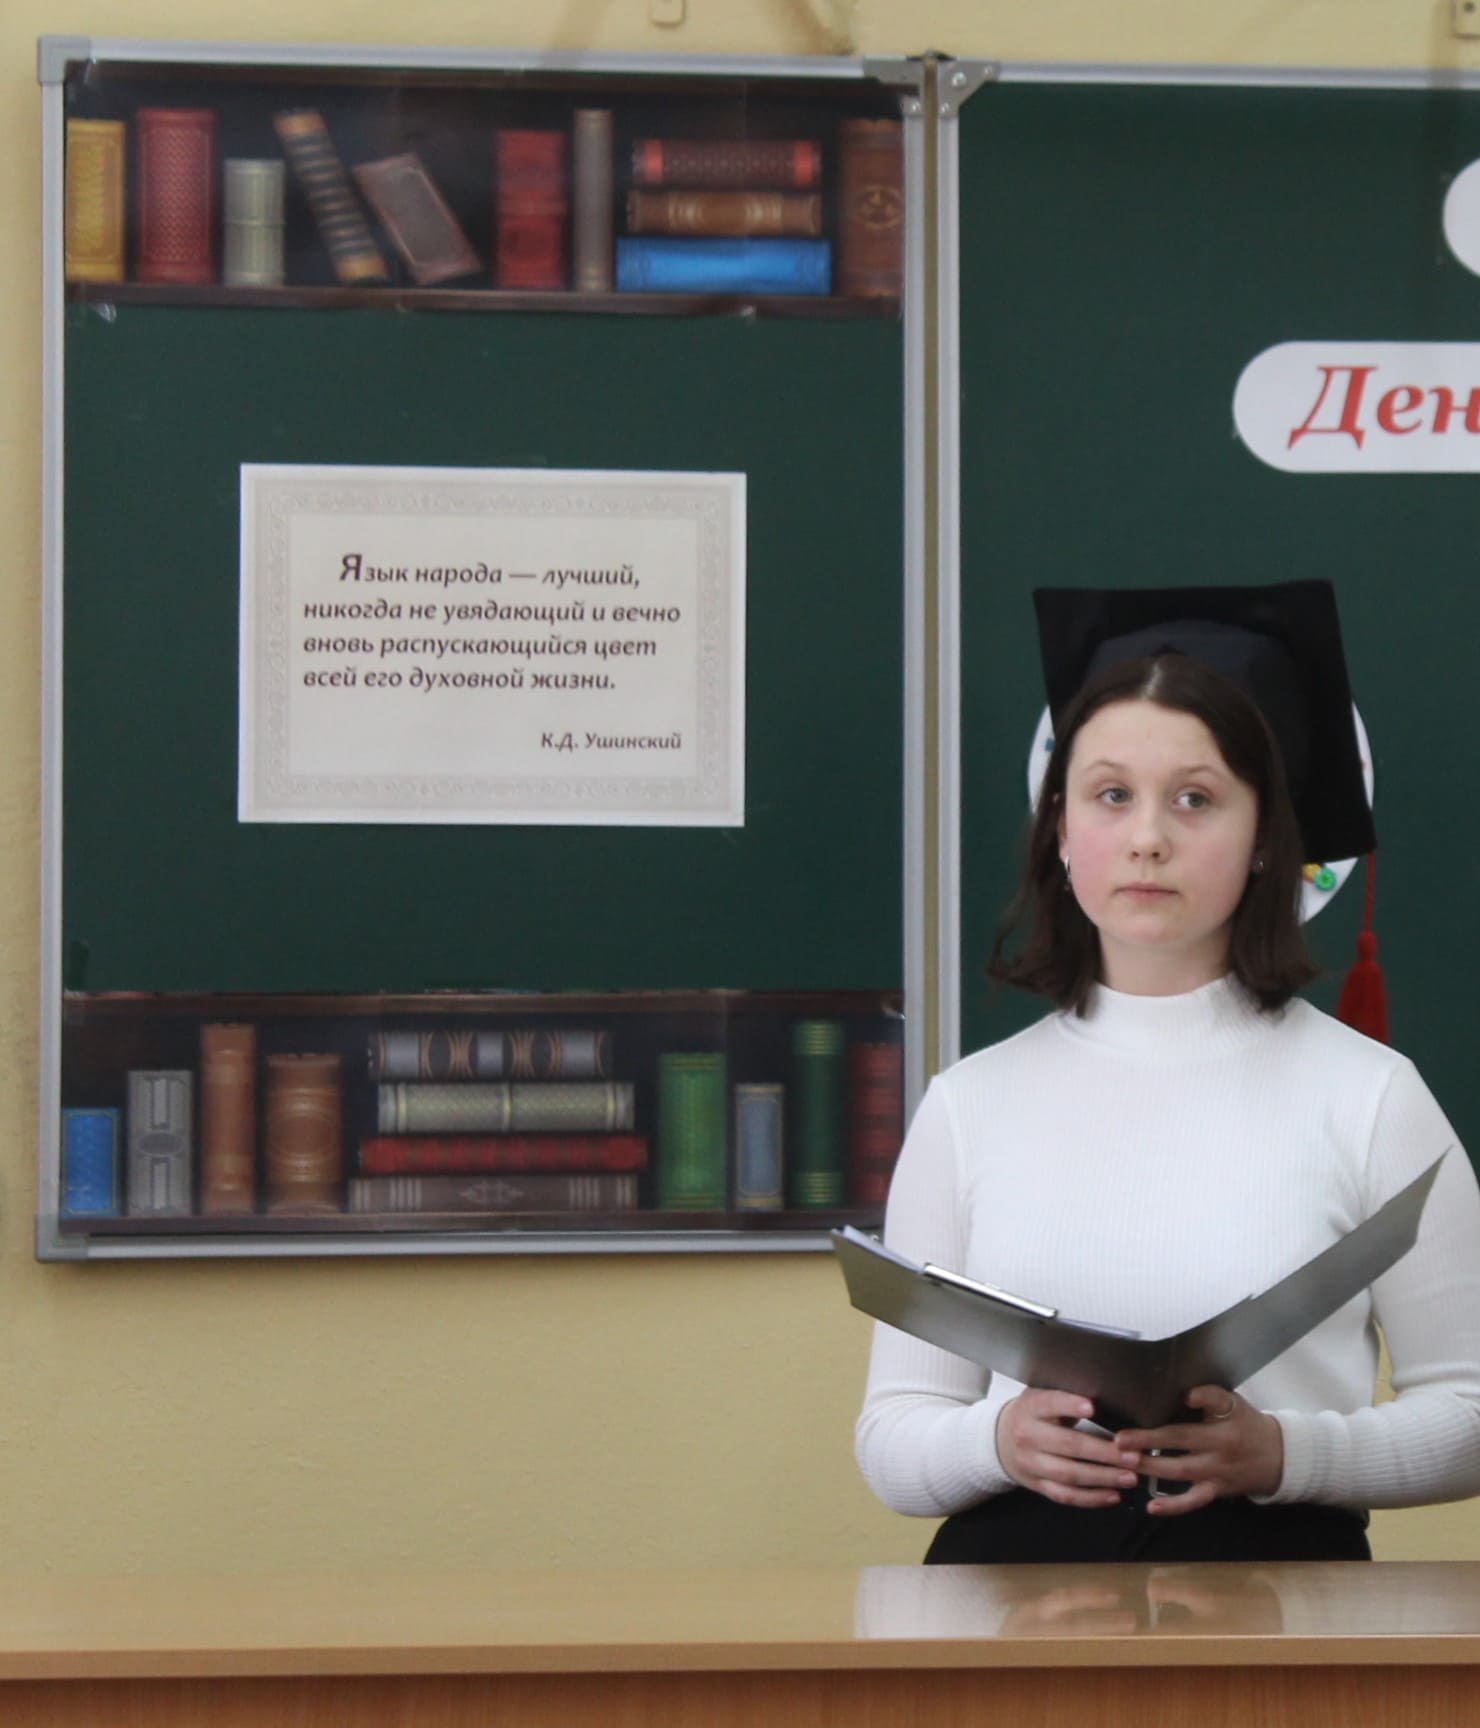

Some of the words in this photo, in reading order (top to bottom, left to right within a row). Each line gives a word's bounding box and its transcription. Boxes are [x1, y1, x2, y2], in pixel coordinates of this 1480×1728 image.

[338, 552, 409, 583] Язык
[414, 561, 503, 590] народа
[541, 563, 641, 591] лучший,
[302, 597, 403, 621] никогда
[408, 603, 438, 621] не
[442, 599, 586, 627] увядающий
[590, 606, 607, 623] и
[611, 606, 682, 624] вечно
[302, 636, 376, 655] вновь
[378, 632, 589, 661] распускающийся
[592, 639, 658, 662] цвет
[302, 663, 358, 688] всей
[362, 670, 404, 689] его
[407, 665, 525, 694] духовной
[529, 672, 617, 691] жизни.
[540, 731, 580, 754] К.Д.
[583, 731, 683, 750] Ушинский
